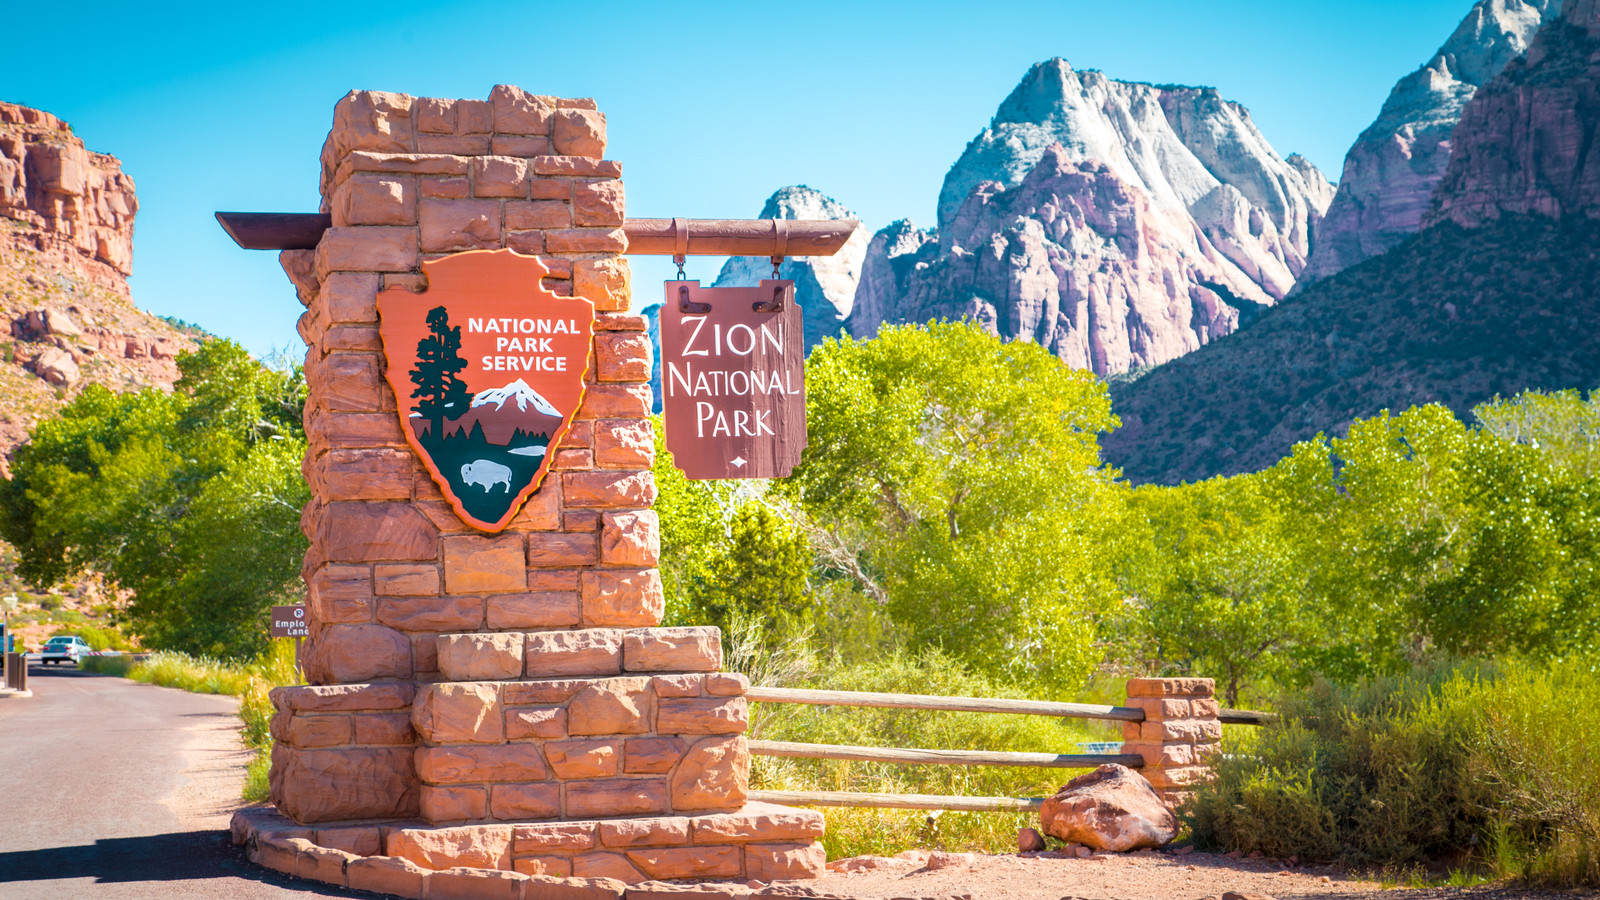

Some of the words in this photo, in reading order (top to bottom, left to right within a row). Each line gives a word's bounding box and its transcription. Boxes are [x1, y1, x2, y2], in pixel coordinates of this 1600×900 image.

[468, 318, 581, 334] NATIONAL
[496, 337, 553, 353] PARK
[481, 355, 567, 371] SERVICE
[667, 361, 800, 397] NATIONAL
[696, 401, 776, 438] PARK
[275, 620, 308, 629] Emplo
